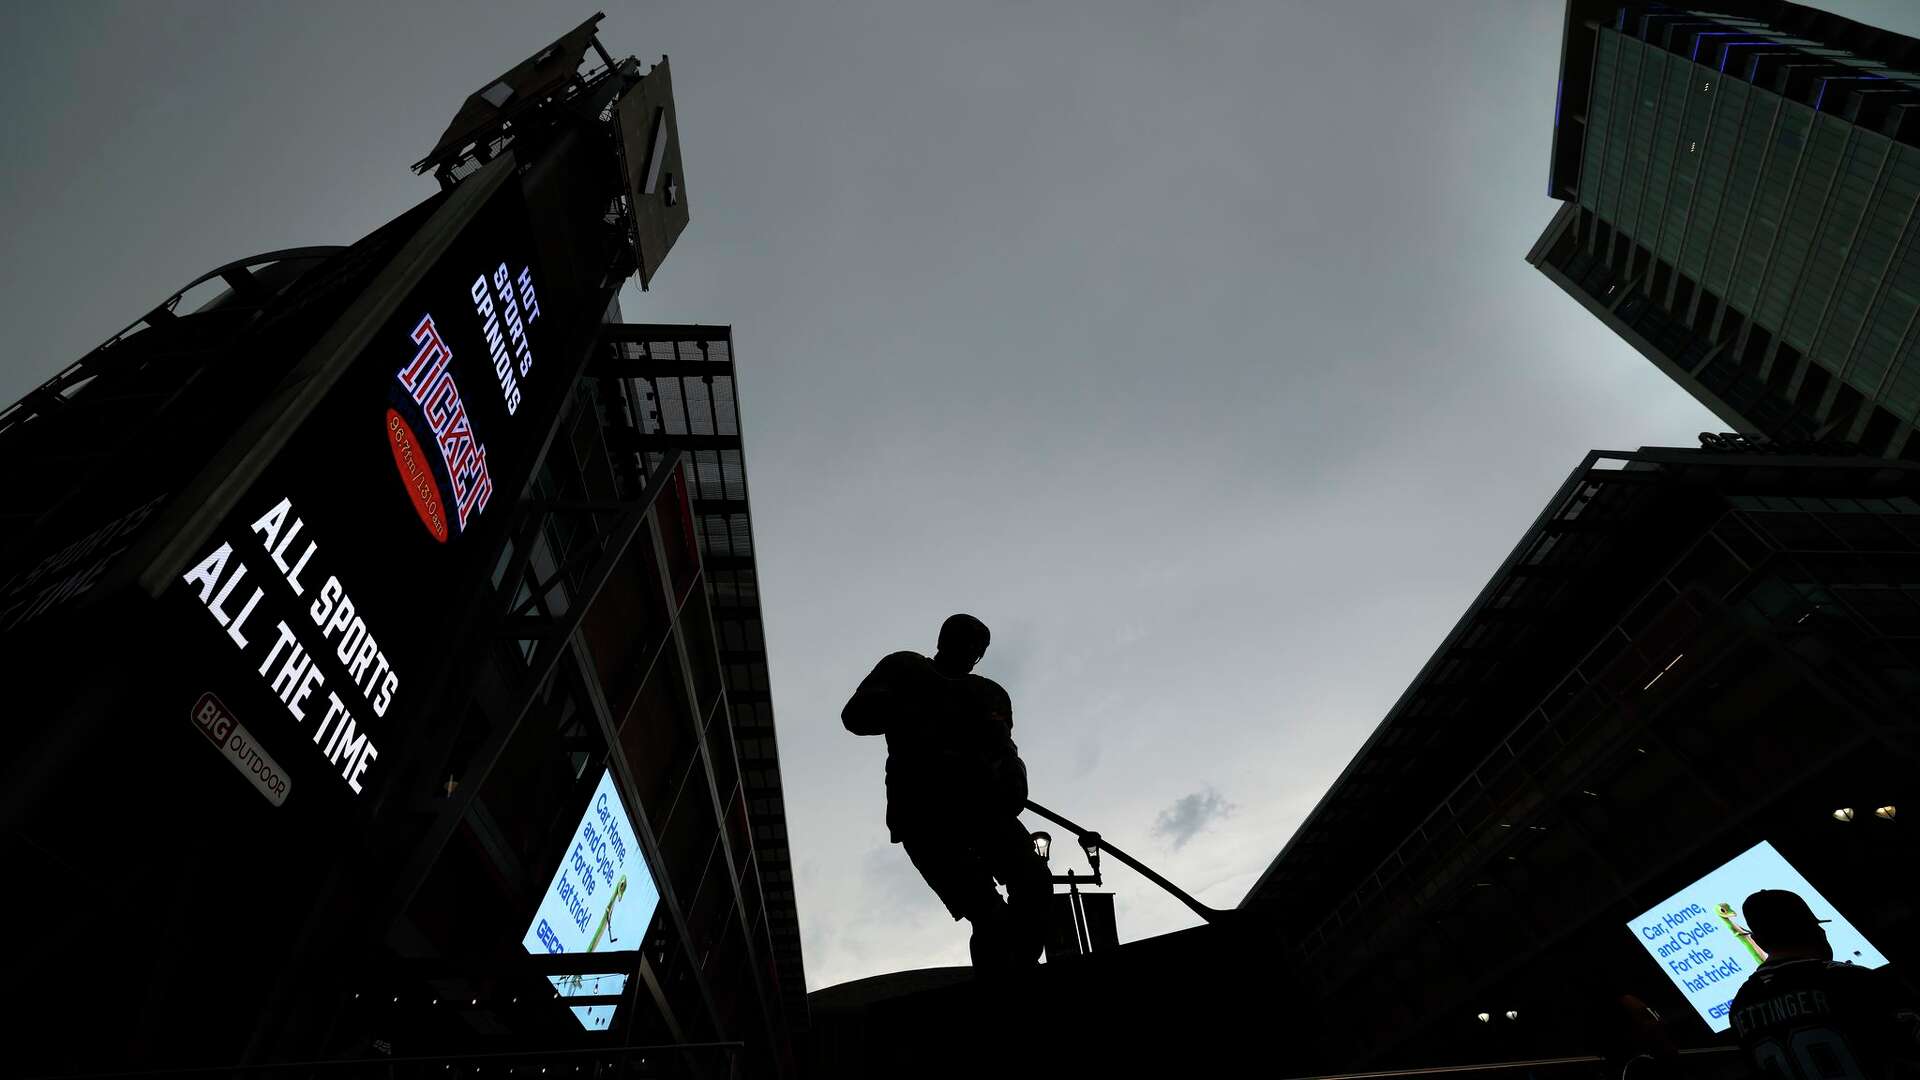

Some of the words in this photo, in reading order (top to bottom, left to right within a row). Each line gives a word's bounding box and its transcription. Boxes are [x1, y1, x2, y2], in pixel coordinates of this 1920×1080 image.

[493, 262, 533, 378] SPORTS
[517, 265, 541, 324] HOT
[471, 274, 521, 416] OPINIONS
[397, 313, 493, 532] TICKET
[250, 497, 318, 597] ALL
[310, 575, 398, 718] SPORTS
[183, 541, 265, 650] ALL
[258, 620, 325, 722] THE
[313, 690, 378, 795] TIME
[197, 700, 231, 740] BIG
[230, 735, 286, 798] OUTDOOR
[583, 822, 602, 854] and
[596, 842, 615, 888] Cycle.
[597, 793, 611, 832] Car,
[607, 817, 626, 869] Home,
[557, 869, 574, 906] hat
[569, 892, 592, 934] trick!
[571, 842, 586, 875] For
[582, 866, 596, 896] the
[1642, 923, 1670, 940] Car,
[1662, 904, 1707, 929] Home,
[1657, 936, 1682, 958] and
[1677, 921, 1718, 945] Cycle.
[1669, 959, 1693, 975] For
[1689, 948, 1714, 965] the
[1683, 974, 1710, 993] hat
[1704, 957, 1742, 983] trick!
